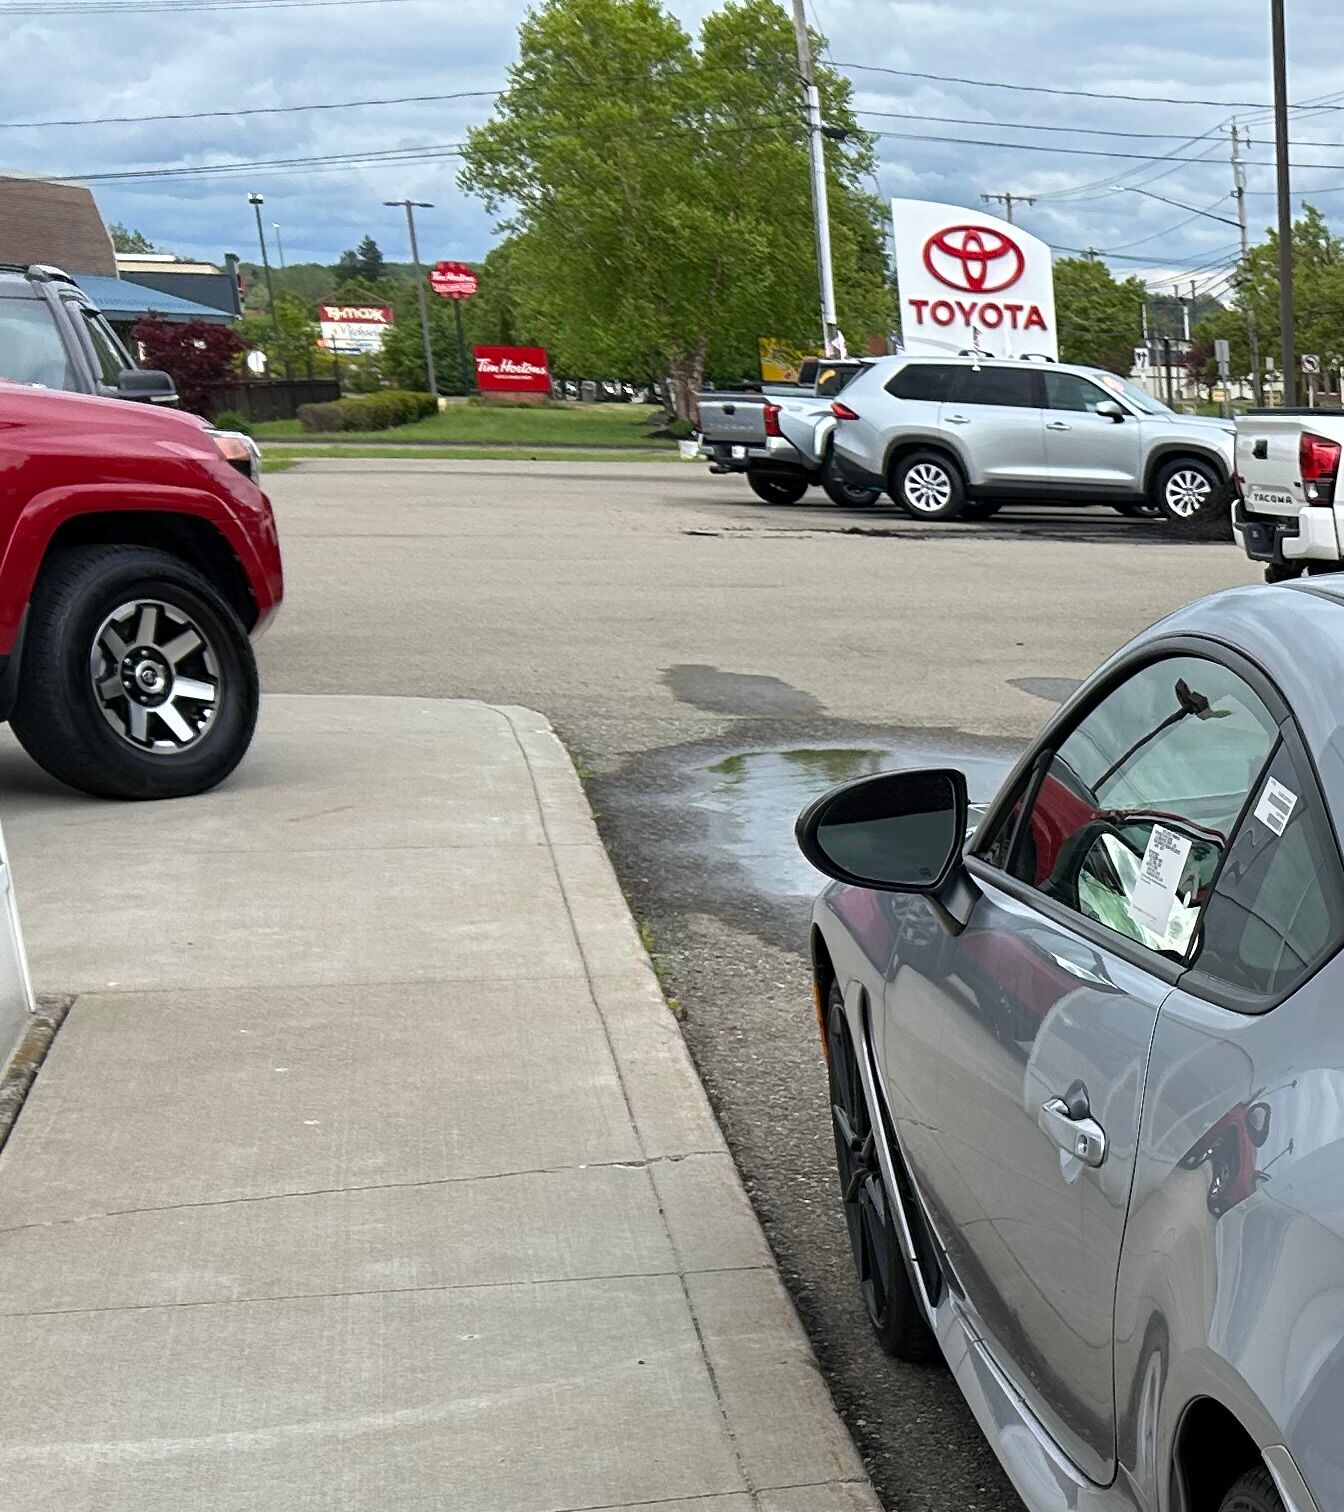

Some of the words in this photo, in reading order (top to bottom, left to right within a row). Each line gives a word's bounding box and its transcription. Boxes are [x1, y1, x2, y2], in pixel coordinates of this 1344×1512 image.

[908, 299, 1048, 331] TOYOTA
[475, 358, 499, 372] Tim
[500, 358, 547, 374] Hortons
[1253, 493, 1293, 505] TACOMA
